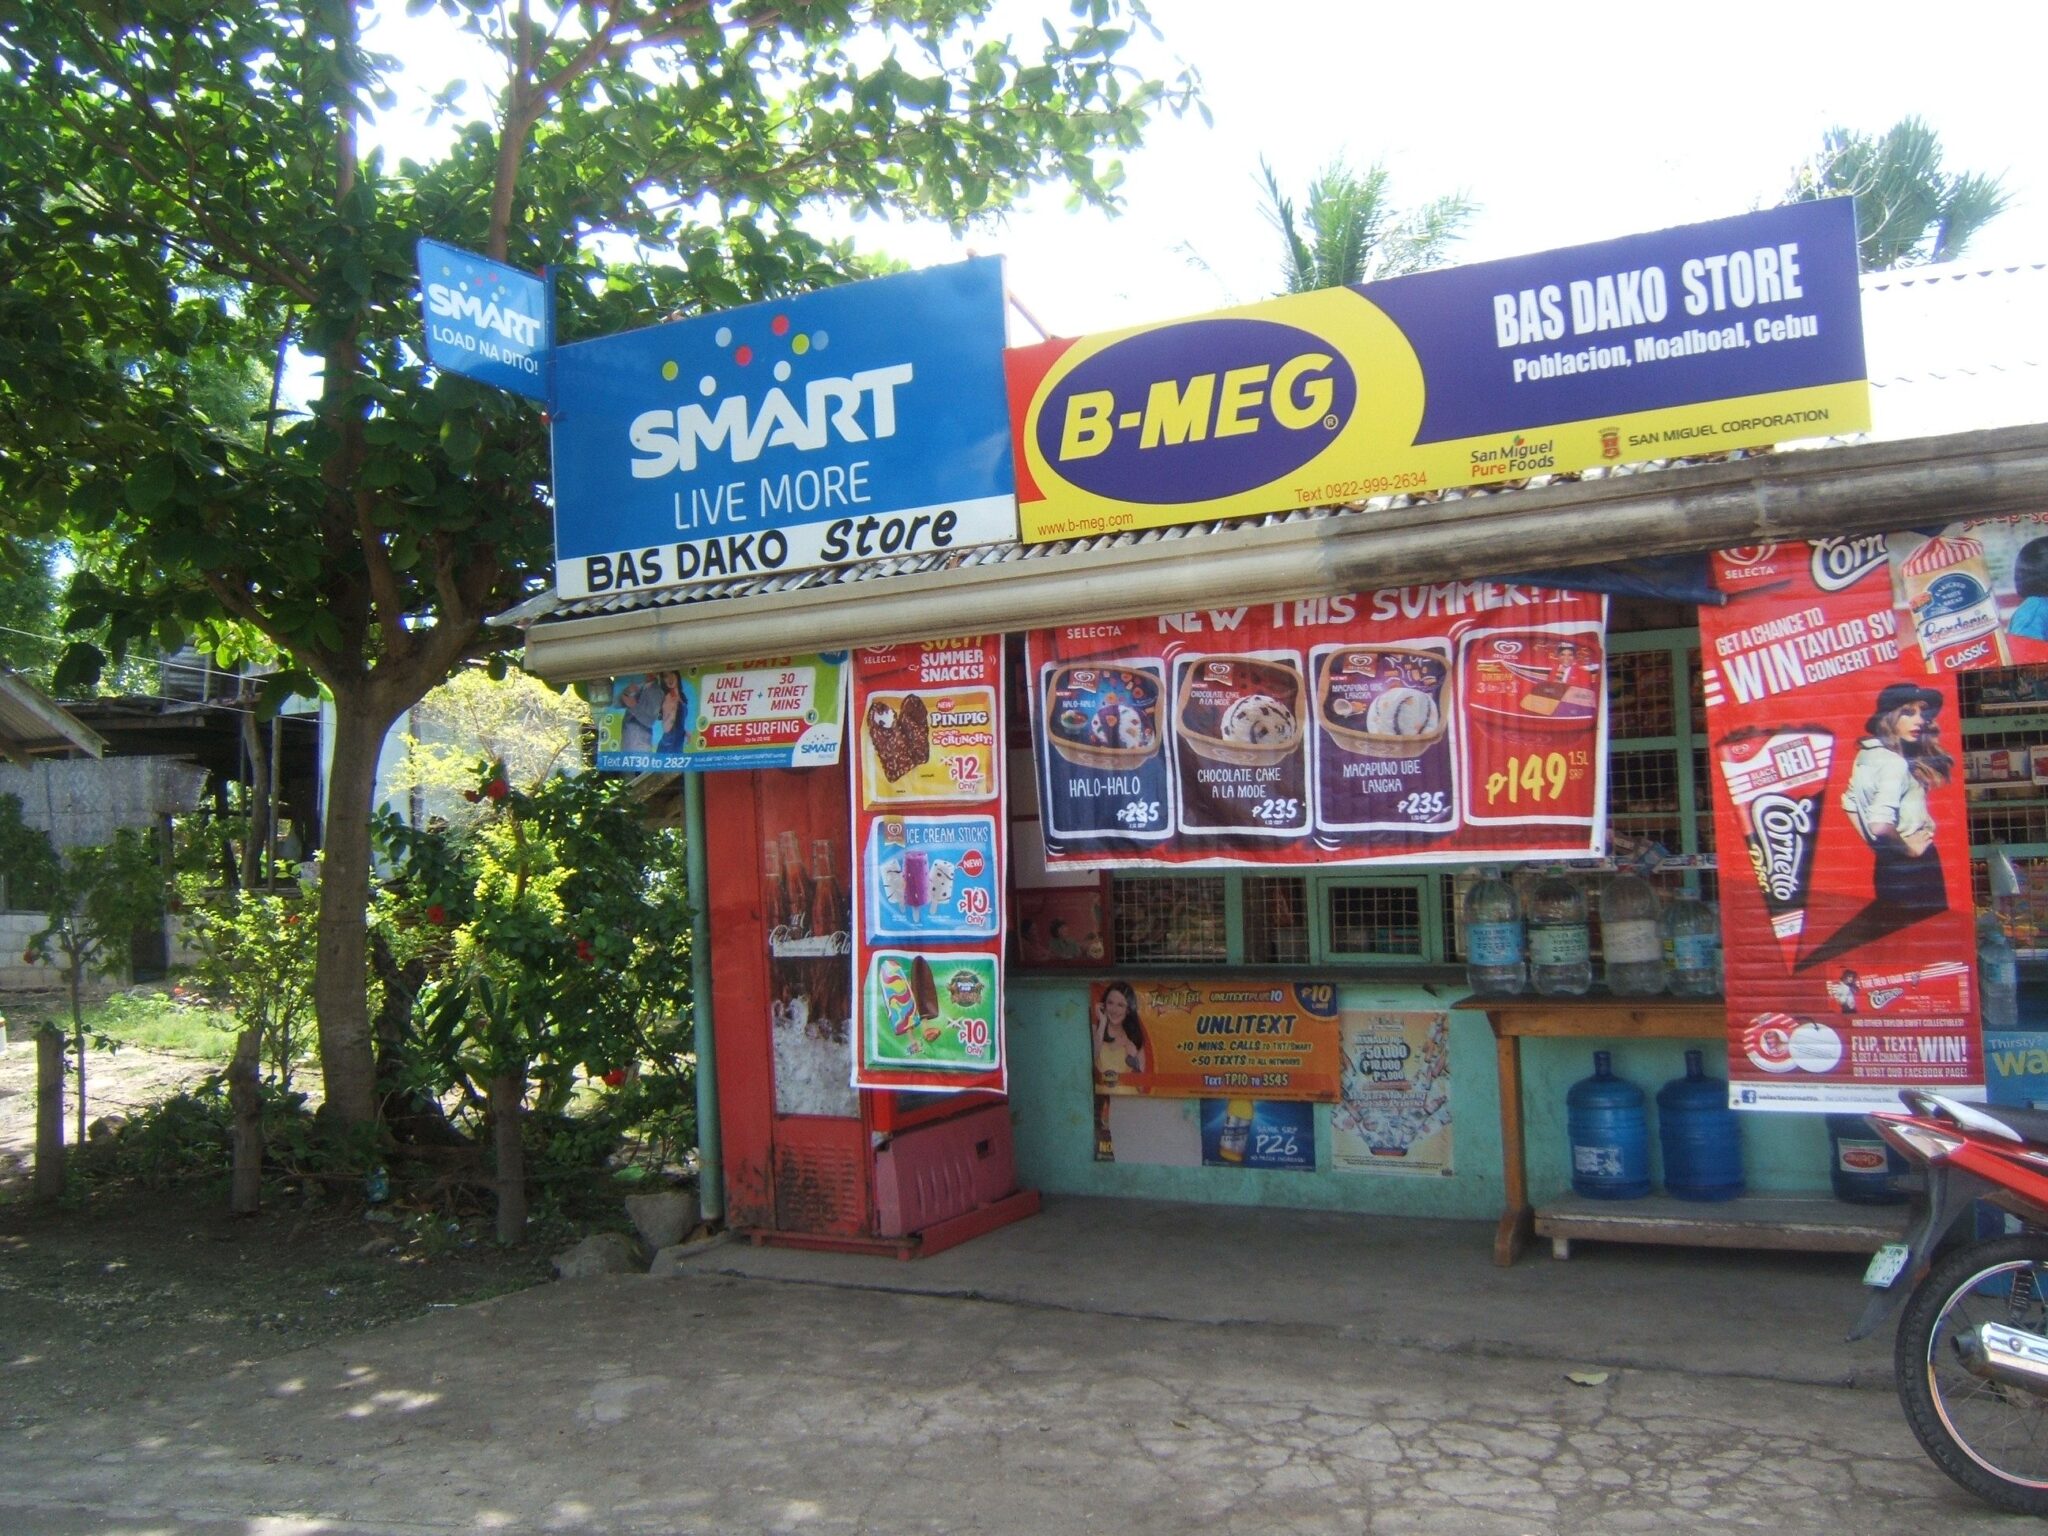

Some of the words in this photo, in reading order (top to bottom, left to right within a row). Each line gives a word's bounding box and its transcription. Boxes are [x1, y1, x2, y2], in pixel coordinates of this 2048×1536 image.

[1494, 284, 1565, 348] BAS
[1569, 266, 1667, 335] DAKO
[1681, 243, 1803, 316] STORE
[428, 282, 540, 347] SMART
[432, 323, 476, 355] LOAD
[479, 338, 500, 361] NA
[502, 348, 539, 376] DITO!
[1513, 346, 1632, 383] Poblacion,
[1634, 321, 1751, 363] Moalboal,
[1754, 313, 1818, 342] Cebu
[1059, 353, 1334, 461] B-MEG
[631, 363, 913, 478] SMART
[1628, 433, 1660, 447] SAN
[1662, 426, 1717, 443] MIGUEL
[1721, 408, 1829, 434] CORPORATION
[1470, 449, 1497, 464] San
[1500, 440, 1553, 461] Miguel
[675, 482, 747, 530] LIVE
[761, 461, 871, 524] MORE
[1295, 487, 1323, 503] Text
[1325, 471, 1427, 499] 0922-999-2634
[1037, 511, 1134, 536] www.b-meg.com
[586, 547, 664, 593] BAS
[676, 530, 789, 580] DAKO
[820, 510, 957, 562] Store
[1725, 566, 1774, 580] SELECTA
[1067, 625, 1122, 640] SELECTA
[1716, 633, 1740, 656] GET
[1742, 630, 1753, 649] A
[1751, 613, 1806, 645] CHANCE
[1804, 607, 1824, 628] TO
[1795, 619, 1869, 660] TAYLOR
[921, 649, 983, 667] SUMMER
[1944, 641, 1989, 668] CLASSIC
[921, 665, 984, 682] SNACKS!
[1721, 640, 1806, 704] WIN
[1805, 646, 1871, 683] CONCERT
[716, 676, 743, 690] UNLI
[779, 673, 795, 684] 30
[707, 692, 727, 704] ALL
[730, 689, 753, 702] NET
[767, 685, 808, 698] TRINET
[713, 704, 747, 718] TEXTS
[771, 699, 801, 711] MINS
[713, 724, 742, 737] FREE
[745, 720, 800, 735] SURFING
[931, 712, 988, 727] PINIPIG
[801, 742, 838, 754] SMART
[602, 756, 620, 767] Text
[621, 756, 649, 768] AT30
[651, 758, 662, 768] to
[663, 757, 692, 768] 2827
[1343, 760, 1397, 777] MACAPUNO
[1400, 759, 1421, 774] UBE
[1774, 745, 1816, 778] RED
[1197, 769, 1251, 783] CHOCOLATE
[1255, 768, 1281, 781] CAKE
[1069, 776, 1140, 797] HALO-HALO
[1212, 787, 1218, 798] A
[1221, 786, 1234, 798] LA
[1238, 785, 1266, 798] MODE
[1362, 778, 1403, 793] LANGKA
[907, 828, 920, 843] ICE
[923, 828, 955, 843] CREAM
[959, 827, 989, 842] STICKS
[1752, 795, 1812, 900] Cornetto
[1197, 1015, 1297, 1034] UNLITEXT
[1229, 1040, 1260, 1050] CALLS
[1917, 1036, 1968, 1062] WIN!
[1191, 1056, 1210, 1065] +50
[1215, 1055, 1246, 1065] TEXTS
[1262, 1074, 1288, 1086] 3545
[1904, 1067, 1944, 1077] FACEBOOK
[1945, 1067, 1968, 1077] PAGE!
